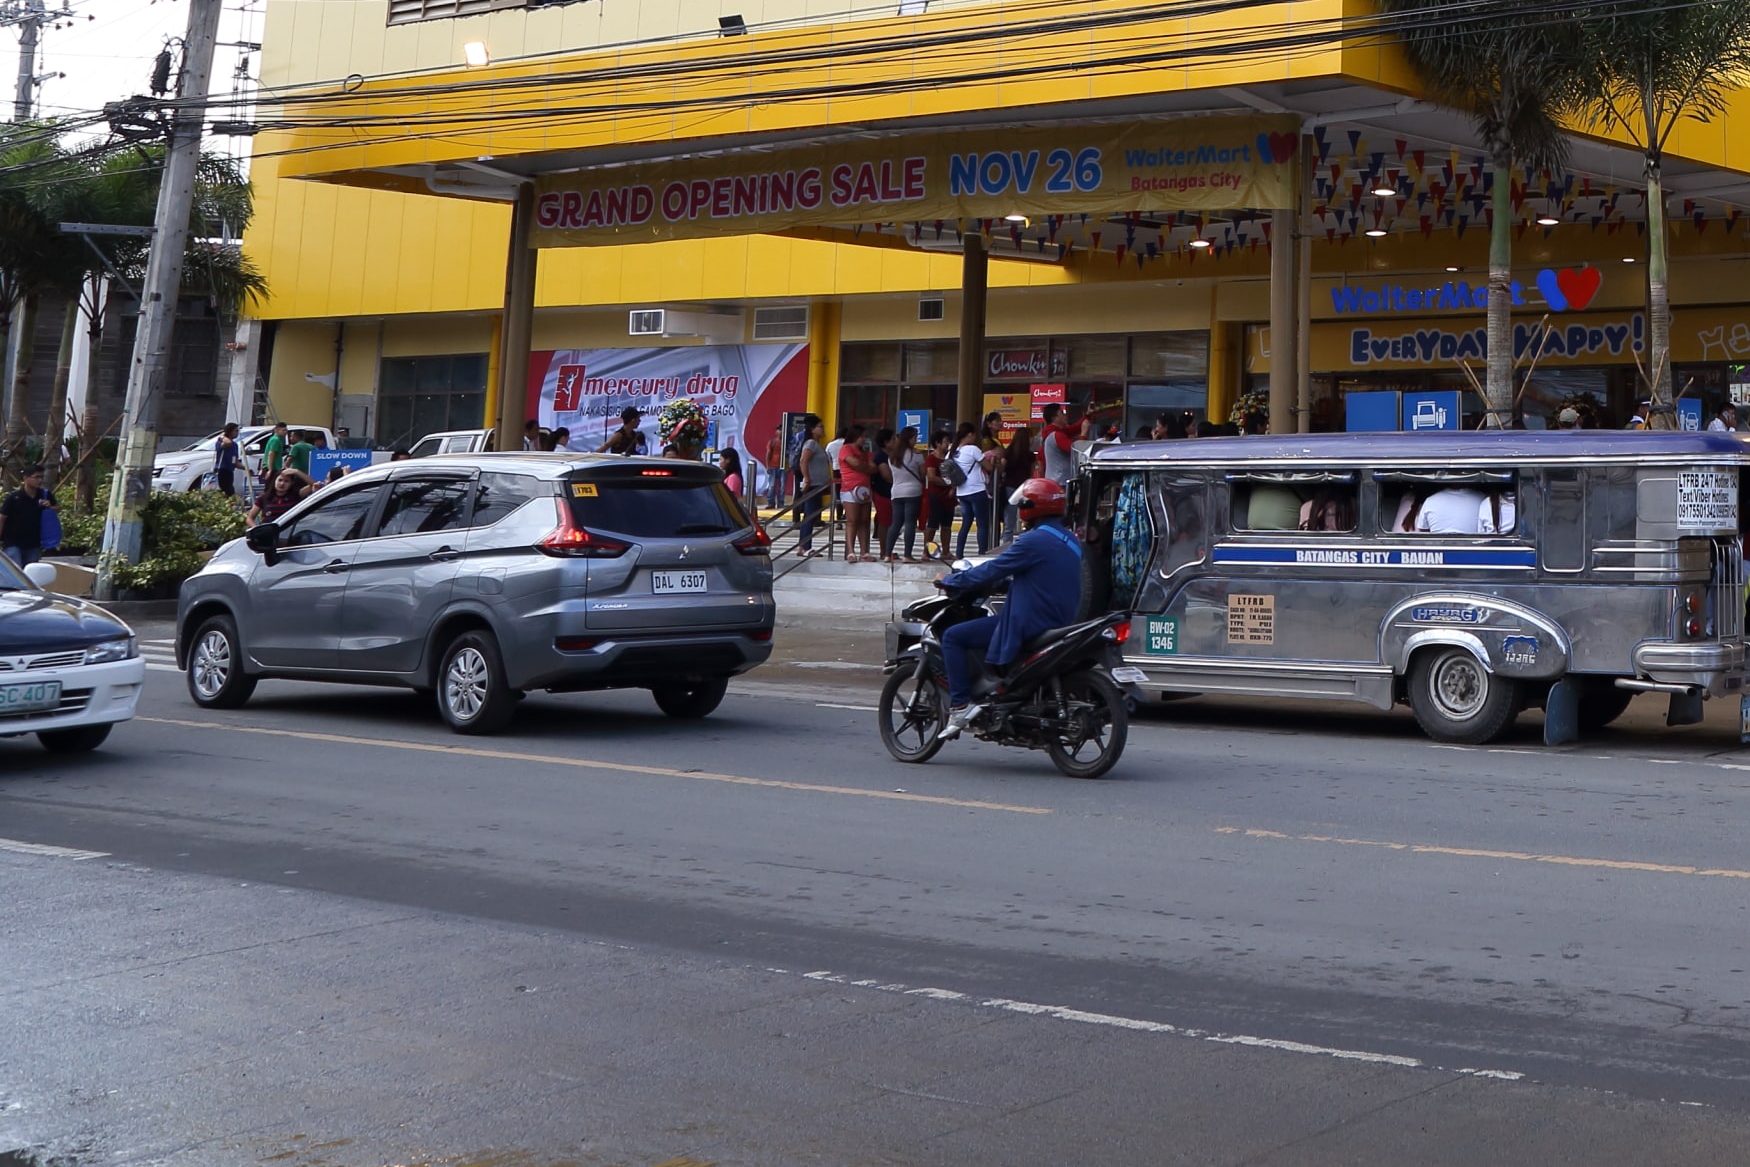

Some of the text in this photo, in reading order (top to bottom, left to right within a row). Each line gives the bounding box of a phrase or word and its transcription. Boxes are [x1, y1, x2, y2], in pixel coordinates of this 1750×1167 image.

[1125, 144, 1252, 169] WalterMart
[536, 147, 1103, 229] GRAND OPENING SALE NOV 26
[1131, 171, 1242, 194] Batangas City
[1332, 279, 1527, 314] WalterMat
[584, 373, 739, 400] mercury drug
[711, 405, 736, 417] BAGO
[1679, 473, 1700, 488] LTFRB
[1296, 550, 1444, 565] BATANGAS CITY BAUAN
[655, 575, 705, 589] DAL 6307
[1237, 597, 1264, 605] LTFRB
[1150, 621, 1175, 634] BW-02
[1151, 636, 1173, 650] 1346
[22, 684, 59, 702] 407
